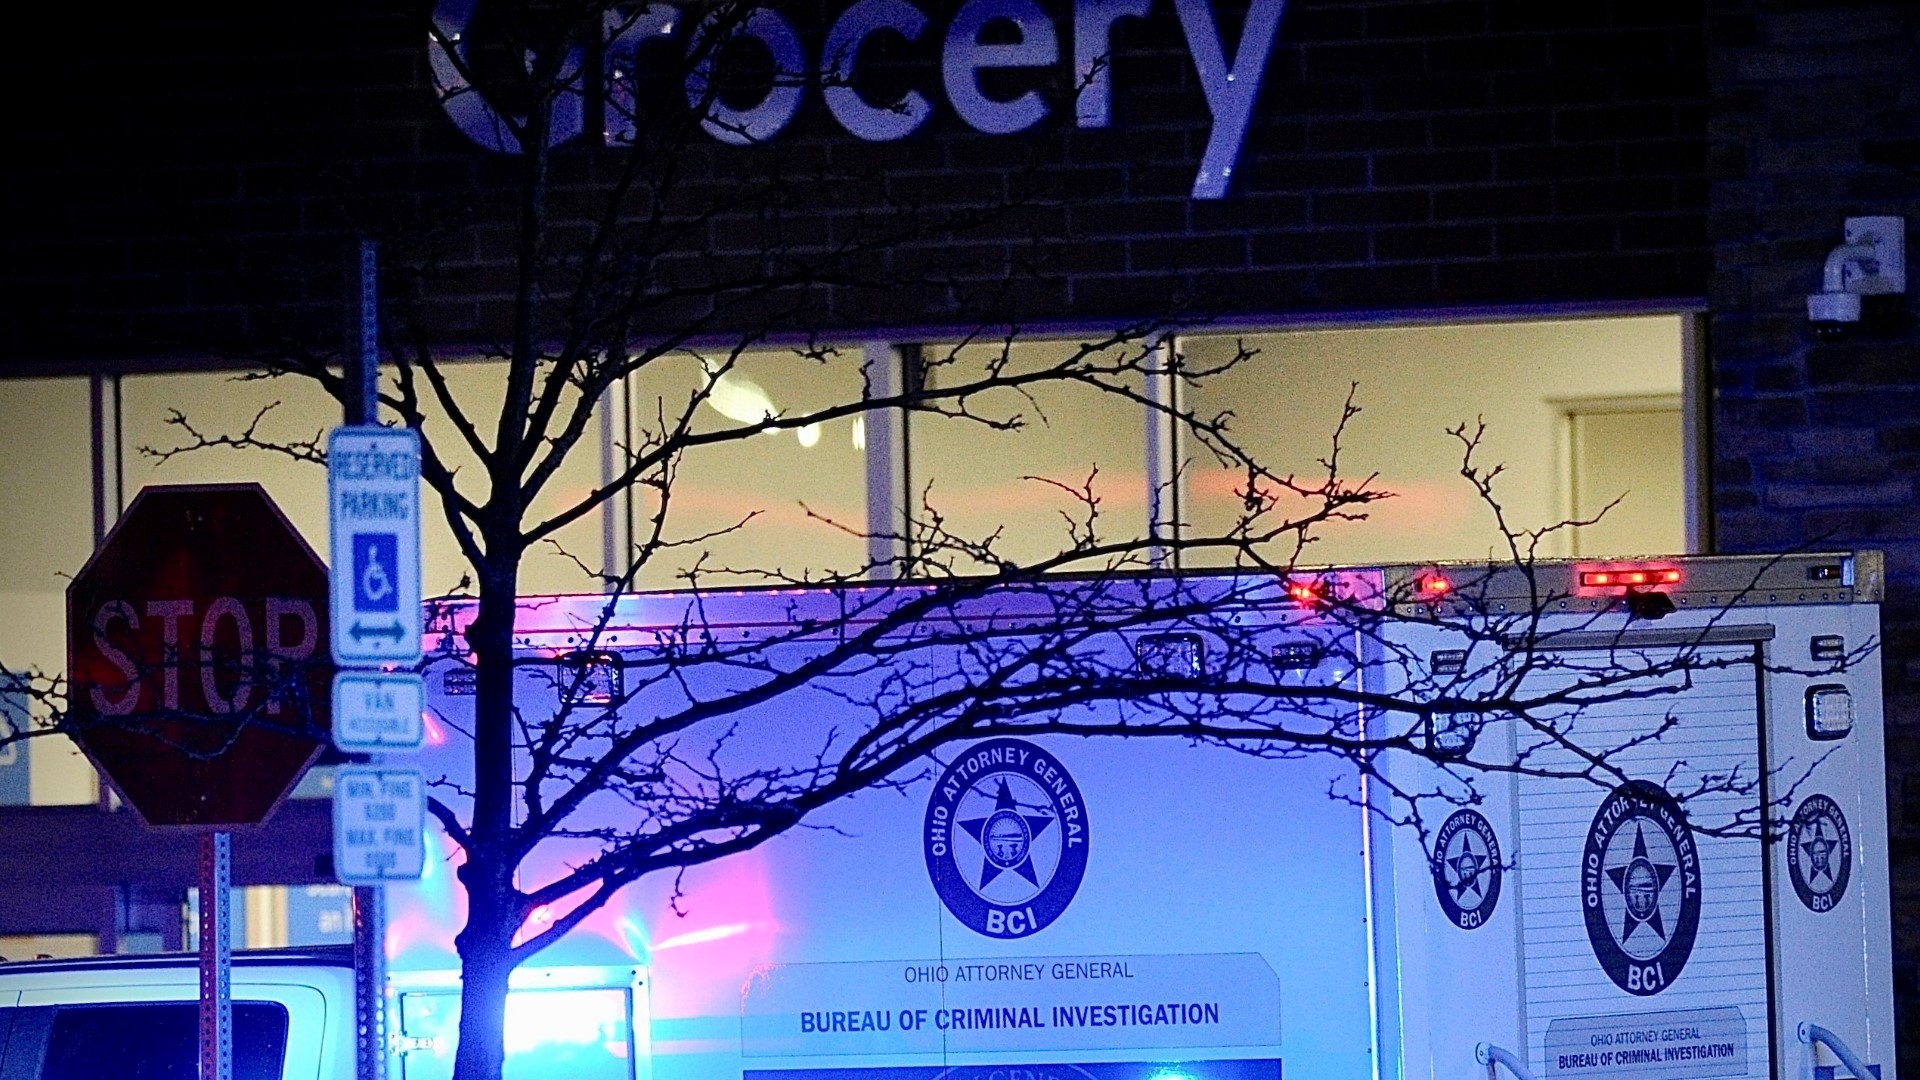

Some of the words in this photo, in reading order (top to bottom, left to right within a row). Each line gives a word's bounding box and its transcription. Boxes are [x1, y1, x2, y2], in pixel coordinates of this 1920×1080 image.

[427, 0, 1284, 198] Grocery
[335, 452, 413, 480] RESERVED
[342, 491, 409, 519] PARKING
[90, 597, 318, 717] STOP
[931, 806, 949, 857] OHIO
[943, 747, 1030, 802] ATTORNEY
[1033, 758, 1083, 848] GENERAL
[1793, 799, 1829, 833] AORNEY
[1440, 813, 1477, 848] ATTORNEY
[1587, 854, 1599, 907] OHIO
[1595, 796, 1655, 849] ATTOR
[1790, 834, 1798, 865] OHIO
[1812, 893, 1833, 910] BCI
[986, 906, 1038, 934] BCI
[1460, 910, 1482, 927] BCI
[904, 966, 949, 983] OHIO
[955, 964, 1045, 982] ATTORNEY
[1051, 962, 1134, 979] GENERAL
[1627, 962, 1665, 991] BCI
[800, 1010, 891, 1033] BUREAU
[899, 1009, 928, 1031] OF
[934, 1007, 1045, 1030] CRIMINAL
[1052, 1003, 1219, 1027] INVESTIGATION
[1590, 1034, 1613, 1047] OHIO
[1615, 1029, 1659, 1045] ATTORNEY
[1661, 1027, 1702, 1042] GENERAL
[1558, 1053, 1598, 1069] BUREAU
[1600, 1051, 1613, 1066] OF
[1615, 1047, 1662, 1065] CRIMINAL
[1664, 1043, 1734, 1063] INVESTIGATION
